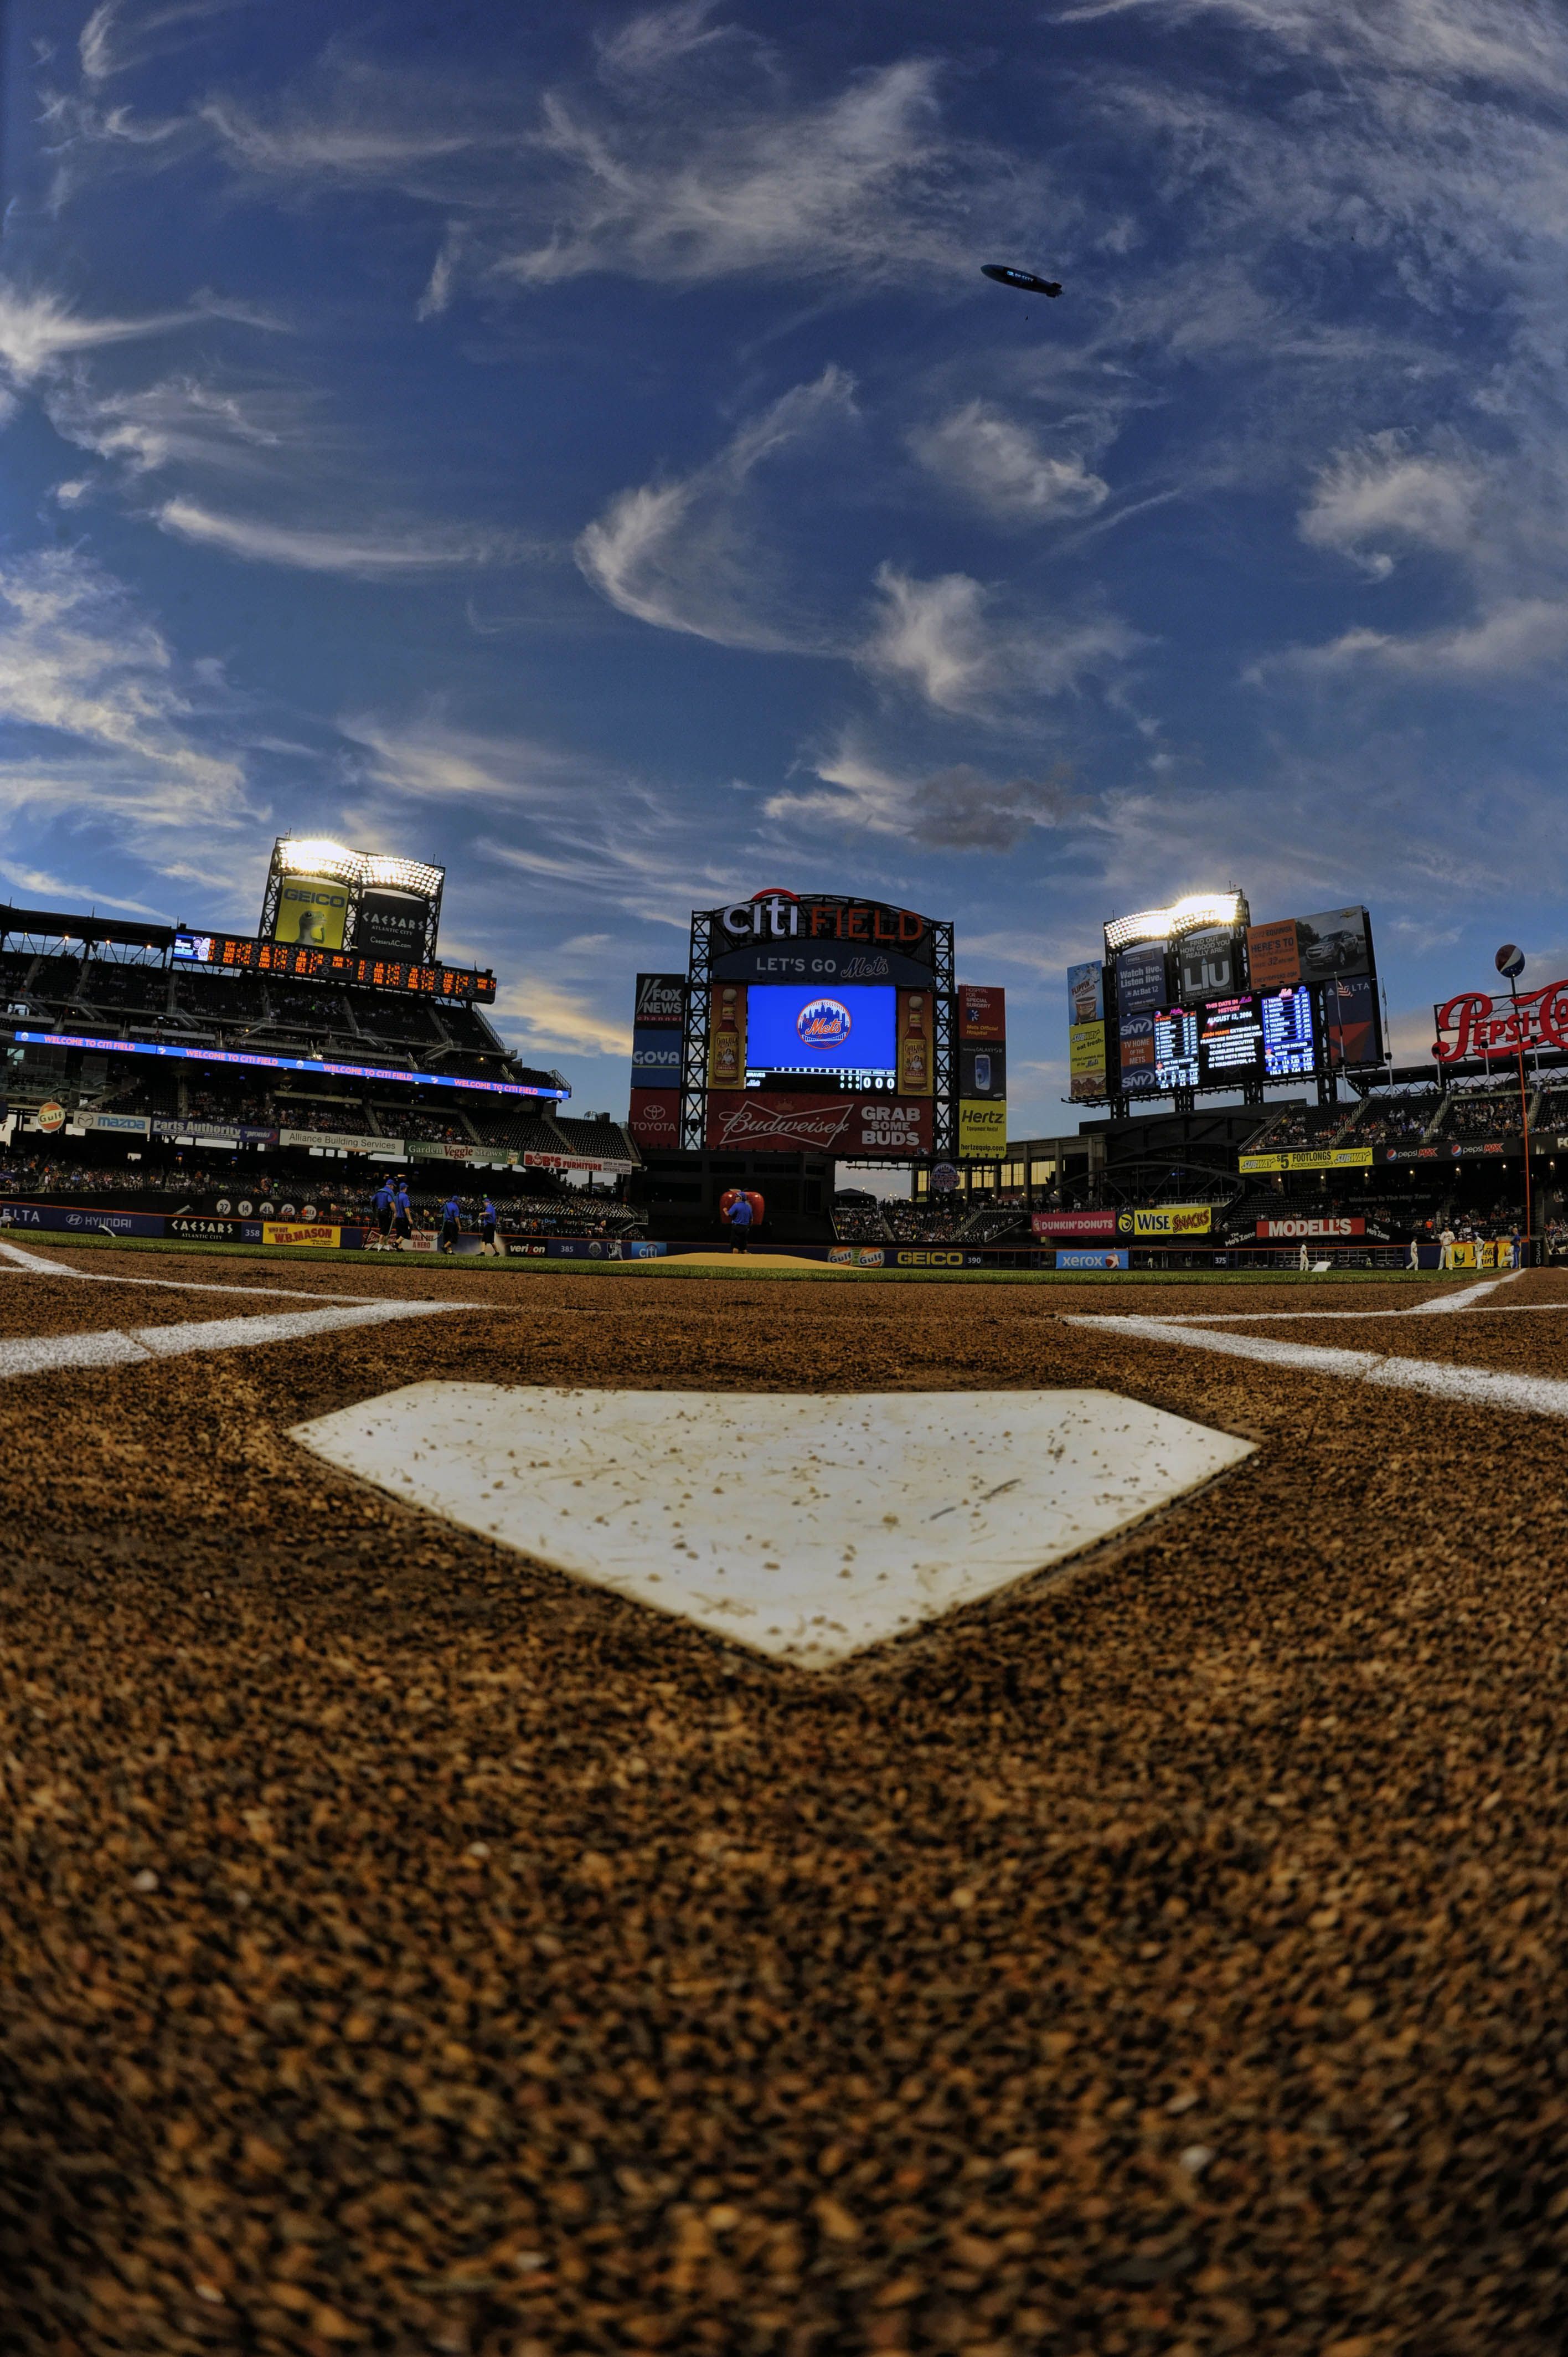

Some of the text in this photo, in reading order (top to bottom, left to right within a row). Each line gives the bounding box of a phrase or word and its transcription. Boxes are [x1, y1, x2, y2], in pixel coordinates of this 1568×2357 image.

[283, 888, 345, 908] GEICO
[362, 912, 425, 931] CAESARS
[811, 907, 924, 940] FIELD
[372, 925, 399, 934] ATLANTIC
[370, 936, 412, 949] CaesarsAC.com
[1196, 943, 1215, 951] GOOD
[1251, 940, 1281, 953] HERE'S
[1282, 937, 1294, 946] TO
[1186, 950, 1209, 959] REALLY
[757, 956, 889, 978] LET'S GO Mets
[1120, 966, 1162, 979] Watch live.
[1184, 957, 1230, 992] LIU
[1121, 975, 1162, 988] Listen live.
[652, 988, 682, 1002] FOX
[642, 1001, 682, 1013] NEWS
[1218, 1005, 1240, 1013] HISTORY
[1207, 1015, 1230, 1024] AUGUST
[805, 1018, 842, 1036] Mets
[1120, 1022, 1148, 1036] SNY
[44, 1036, 83, 1046] WELCOME
[1071, 1029, 1101, 1043] SUBWAY
[1132, 1038, 1149, 1047] HOME
[1077, 1042, 1086, 1051] eat
[185, 1049, 225, 1061] WELCOME
[228, 1053, 239, 1062] TO
[240, 1055, 255, 1064] CITI
[633, 1051, 679, 1064] GOYA
[1129, 1056, 1146, 1064] METS
[323, 1064, 362, 1074] WELCOME
[454, 1080, 491, 1090] WELCOME
[875, 1077, 894, 1089] 0 0
[1122, 1074, 1149, 1088] SNY
[39, 1112, 62, 1123] Gulf
[861, 1106, 920, 1121] GRAB
[962, 1110, 1004, 1123] Hertz
[97, 1116, 145, 1130] mazda
[154, 1120, 185, 1130] Parts
[186, 1122, 241, 1136] Authority
[632, 1121, 677, 1132] TOYOTA
[719, 1111, 849, 1133] Budweiser
[871, 1121, 910, 1131] SOME
[289, 1133, 395, 1150] Alliance Building Services
[862, 1131, 920, 1146] BUDS
[408, 1144, 503, 1159] Garden Veggie Straws
[1398, 1147, 1438, 1159] pepsi MAX
[1463, 1143, 1504, 1154] pepsi MAX
[525, 1153, 561, 1167] BOB'S
[1241, 1157, 1276, 1170] SUBWAY
[1277, 1154, 1289, 1169] $5
[1292, 1151, 1331, 1162] FOOTLONGS
[1334, 1151, 1371, 1165] SUBWAY
[563, 1161, 602, 1171] FURNITURE
[85, 1216, 132, 1228] HYUNDAI
[171, 1219, 234, 1234] CAESARS
[1042, 1219, 1113, 1230] DUNKIN' DONUTS
[1137, 1210, 1209, 1233] WISE SNACKS
[1268, 1218, 1352, 1237] MODELL'S
[1225, 1232, 1256, 1247] Mo's Zone
[1376, 1229, 1390, 1241] Zone
[509, 1244, 545, 1253] verizon
[639, 1246, 657, 1258] citi
[829, 1253, 852, 1264] Gulf
[859, 1254, 881, 1264] Gulf
[897, 1252, 963, 1265] GEICO
[1063, 1257, 1102, 1266] xerox
